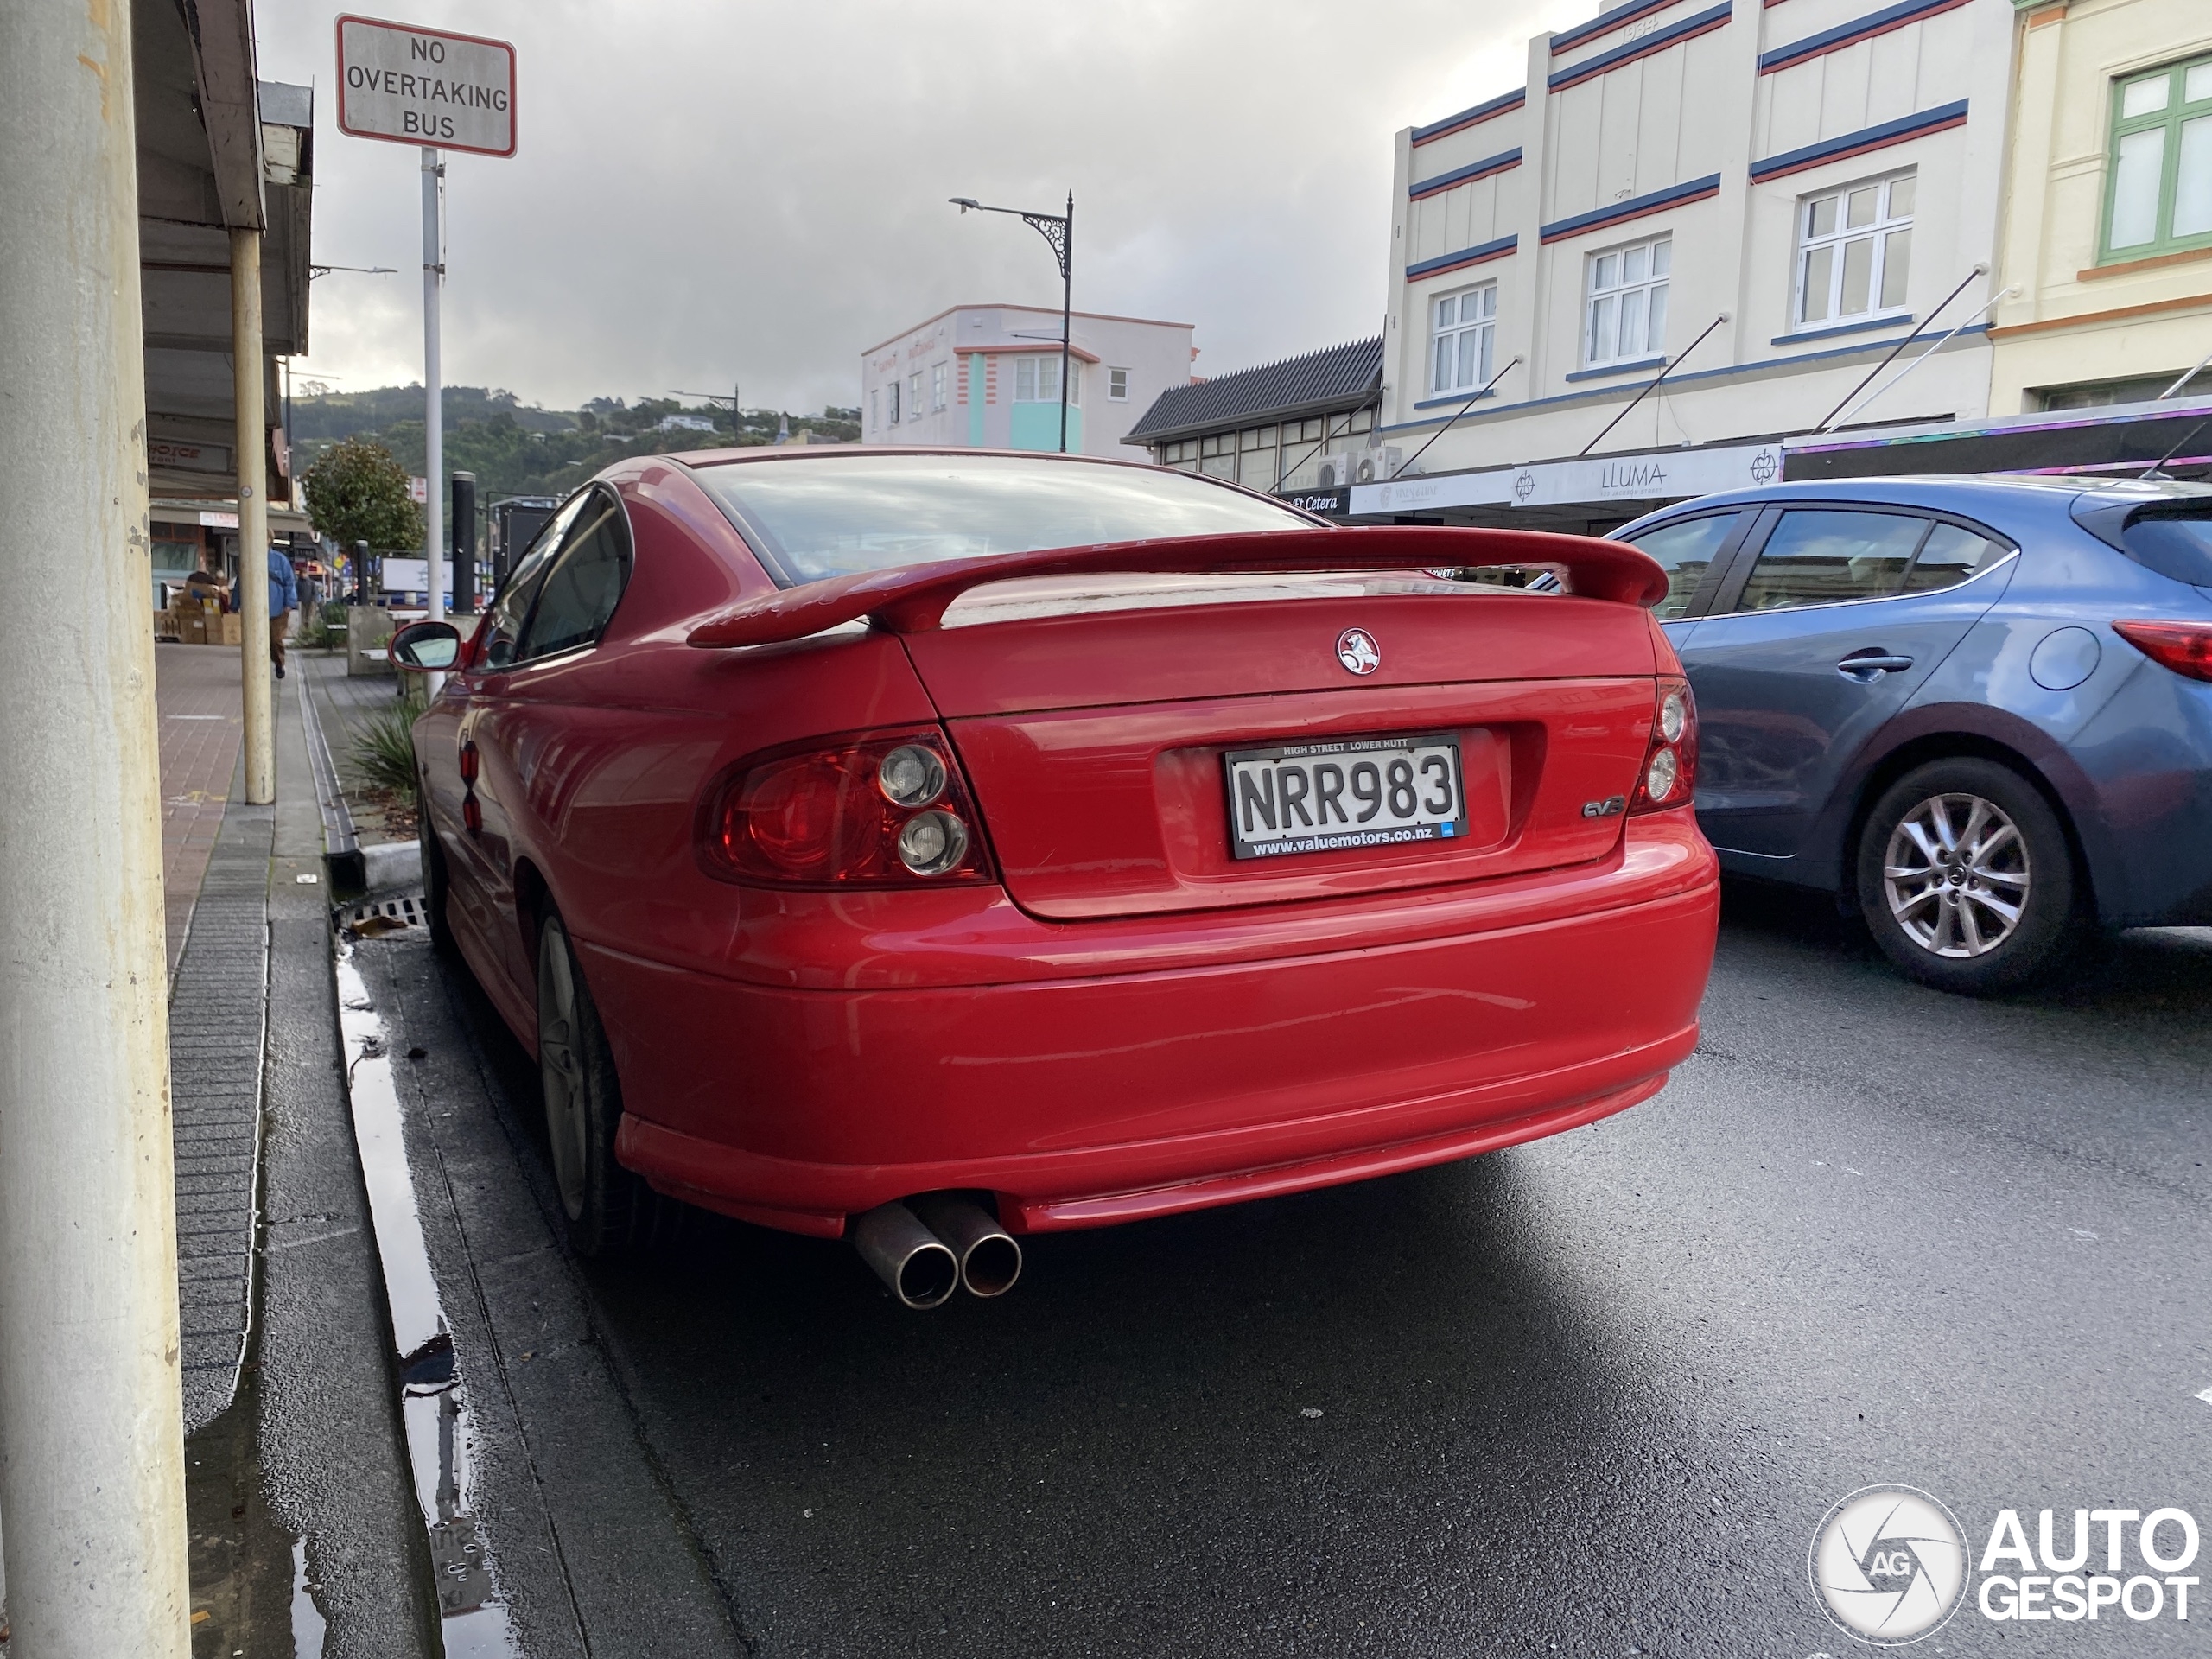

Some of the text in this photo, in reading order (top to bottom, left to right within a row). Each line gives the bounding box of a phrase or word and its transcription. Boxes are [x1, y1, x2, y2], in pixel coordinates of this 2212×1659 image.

[1622, 15, 1659, 46] 1934
[411, 37, 445, 64] NO
[347, 66, 508, 111] OVERTAKING
[404, 111, 454, 139] BUS
[150, 444, 201, 458] HOICE
[1602, 462, 1668, 488] LLUMA
[1306, 495, 1338, 511] Cetera
[1283, 739, 1408, 755] HIGH STREET LOWER HUTT
[1238, 754, 1453, 832] NRR983
[1582, 795, 1626, 817] CV8
[1253, 827, 1433, 855] www.valuemotors.co.nz
